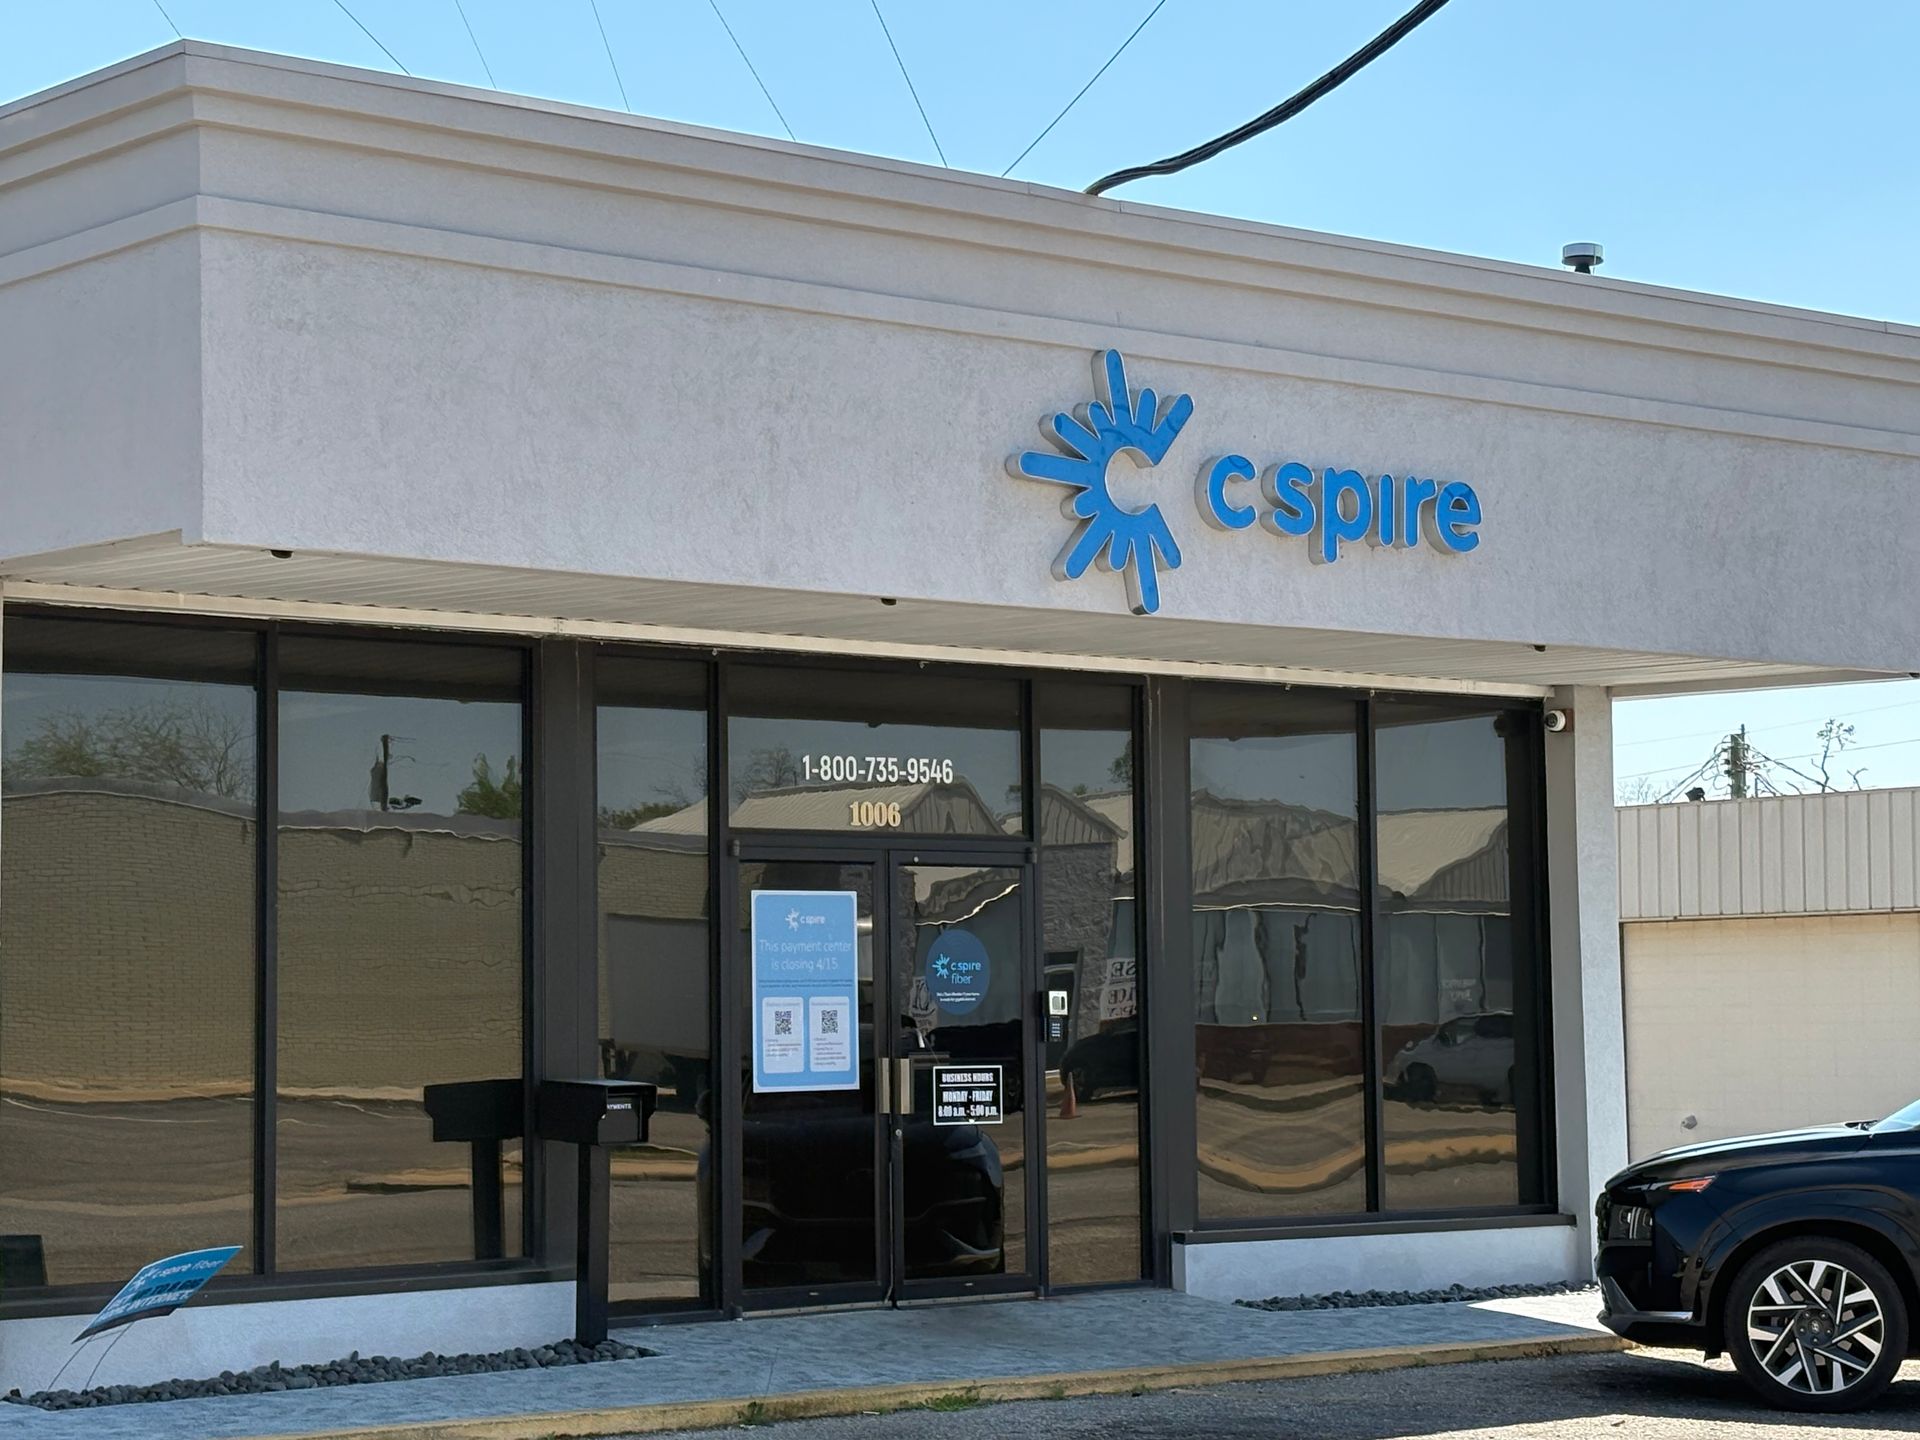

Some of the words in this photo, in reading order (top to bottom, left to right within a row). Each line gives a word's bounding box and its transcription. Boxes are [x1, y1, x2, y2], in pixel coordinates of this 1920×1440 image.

[802, 754, 954, 784] 1-800-735-9546
[850, 801, 901, 827] 1006
[759, 939, 779, 952] This
[781, 941, 822, 955] payment
[823, 941, 852, 953] center
[770, 958, 780, 970] is
[781, 958, 814, 973] closing
[816, 957, 839, 971] 4/15
[951, 973, 973, 984] fiber
[942, 1073, 972, 1083] BUSINESS
[972, 1072, 994, 1082] HOURS
[942, 1090, 968, 1103] MONDAY
[972, 1090, 993, 1102] FRIDAY
[970, 1104, 985, 1117] 5:00
